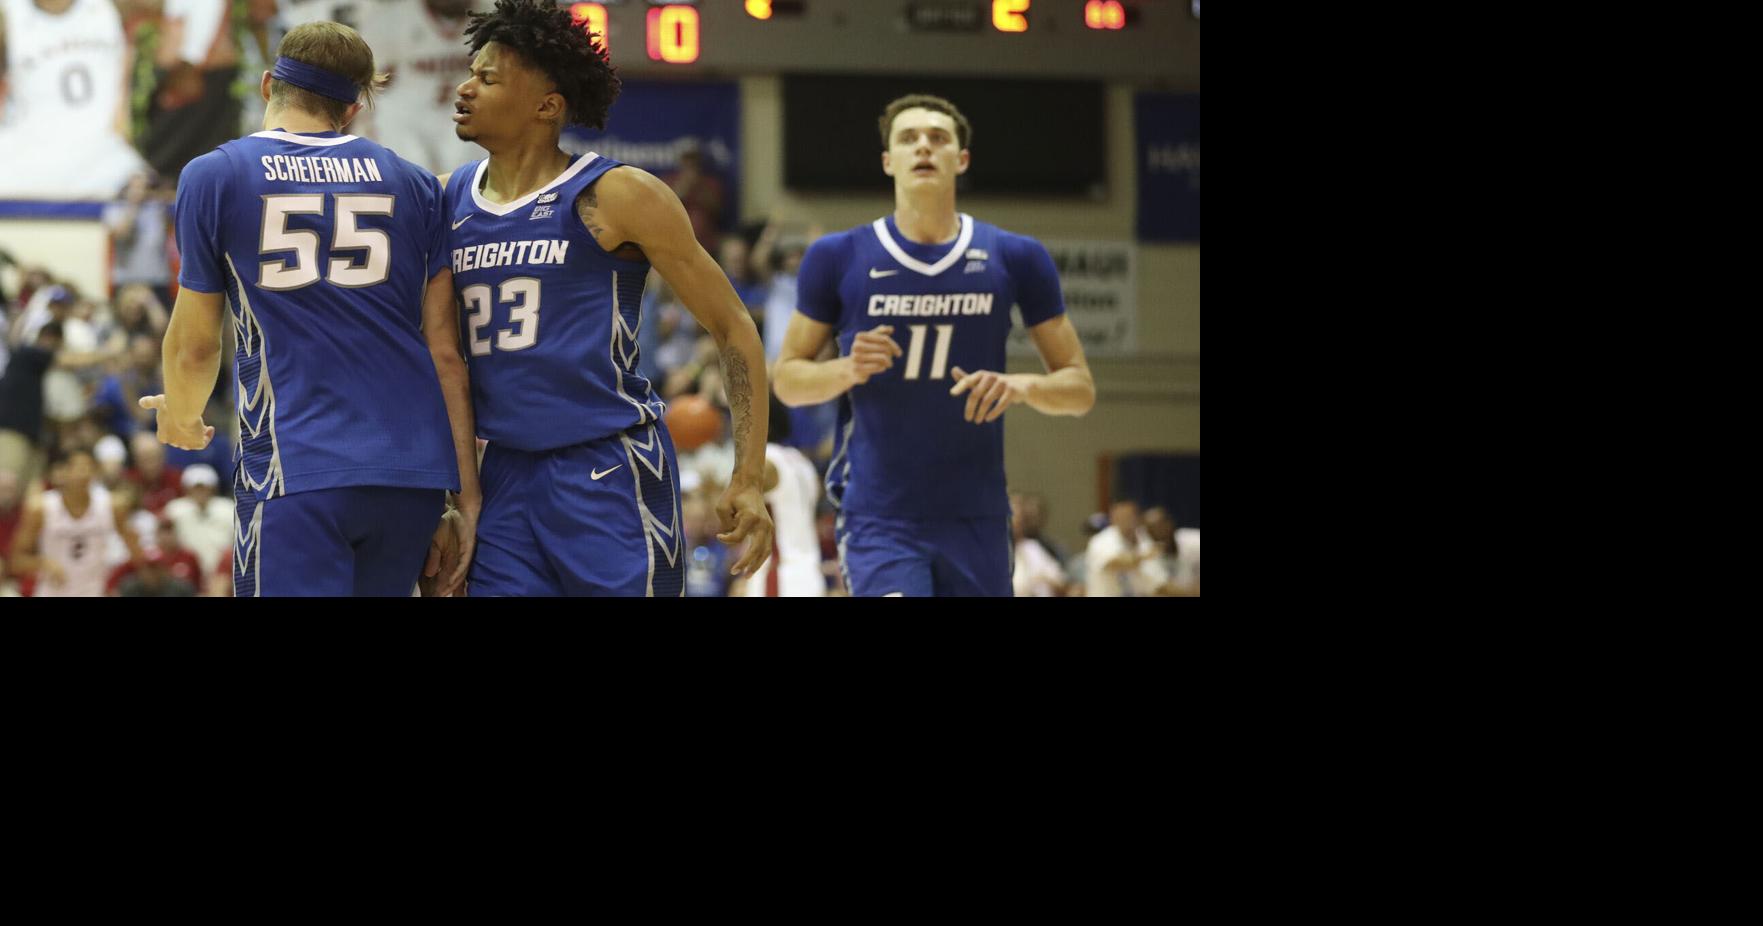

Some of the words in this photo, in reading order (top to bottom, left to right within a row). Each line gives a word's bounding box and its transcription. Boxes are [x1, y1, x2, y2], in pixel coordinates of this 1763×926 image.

[261, 155, 383, 183] SCHEIERMAN
[254, 193, 395, 291] 55
[451, 239, 569, 274] REIGHTON
[461, 276, 541, 357] 23
[867, 293, 993, 317] CREIGHTON
[904, 324, 953, 380] 11
